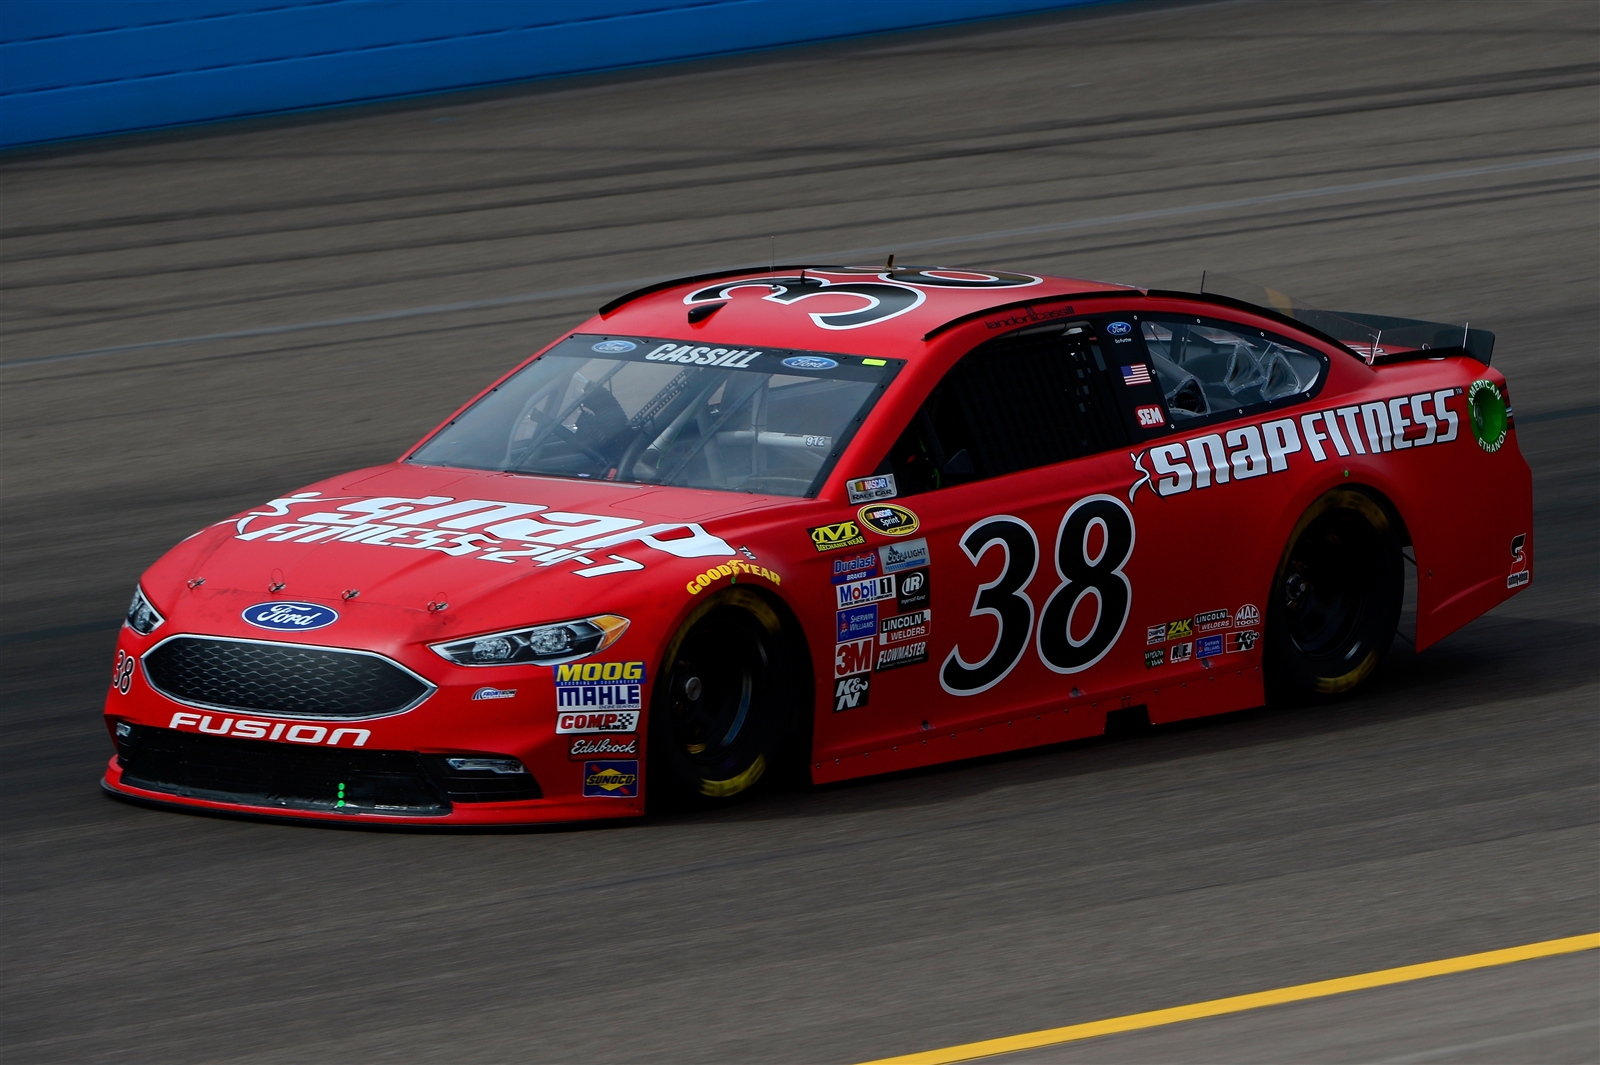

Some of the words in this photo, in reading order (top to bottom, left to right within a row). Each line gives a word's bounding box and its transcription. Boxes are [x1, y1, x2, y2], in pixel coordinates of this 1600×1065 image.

[645, 343, 762, 368] CASSILL
[1468, 379, 1502, 405] AMERICAN
[1137, 407, 1164, 425] SEM
[1302, 388, 1460, 462] FITNESS
[805, 436, 826, 447] 912
[1478, 429, 1507, 453] ETHANOL
[864, 478, 887, 491] NASCAR
[852, 490, 874, 500] RACE
[875, 488, 892, 498] CAR
[880, 516, 900, 527] Sprint
[816, 542, 848, 552] MECHANIX
[847, 535, 865, 546] WEAR
[907, 547, 926, 558] LIGHT
[834, 553, 875, 574] Duralast
[846, 571, 867, 581] BRAKES
[840, 580, 877, 603] Mobil
[939, 493, 1136, 697] 38
[257, 604, 319, 627] Ford
[850, 612, 875, 624] SHERWIN
[1196, 612, 1226, 624] LINCOLN
[1236, 605, 1259, 620] MAC
[849, 621, 875, 632] WILLIAMS
[882, 613, 922, 632] LINCOLN
[1169, 618, 1192, 634] ZAK
[1201, 620, 1230, 631] WELDERS
[890, 626, 926, 641] WELDERS
[836, 638, 873, 677] 3M
[876, 641, 926, 670] FLOWMASTER
[112, 649, 136, 696] 38
[556, 662, 644, 682] MOOG
[558, 685, 640, 707] MAHLE
[169, 712, 371, 746] FUSION
[560, 714, 618, 730] COMP
[571, 738, 636, 755] Edelbrock
[587, 774, 634, 786] SUNOCO
